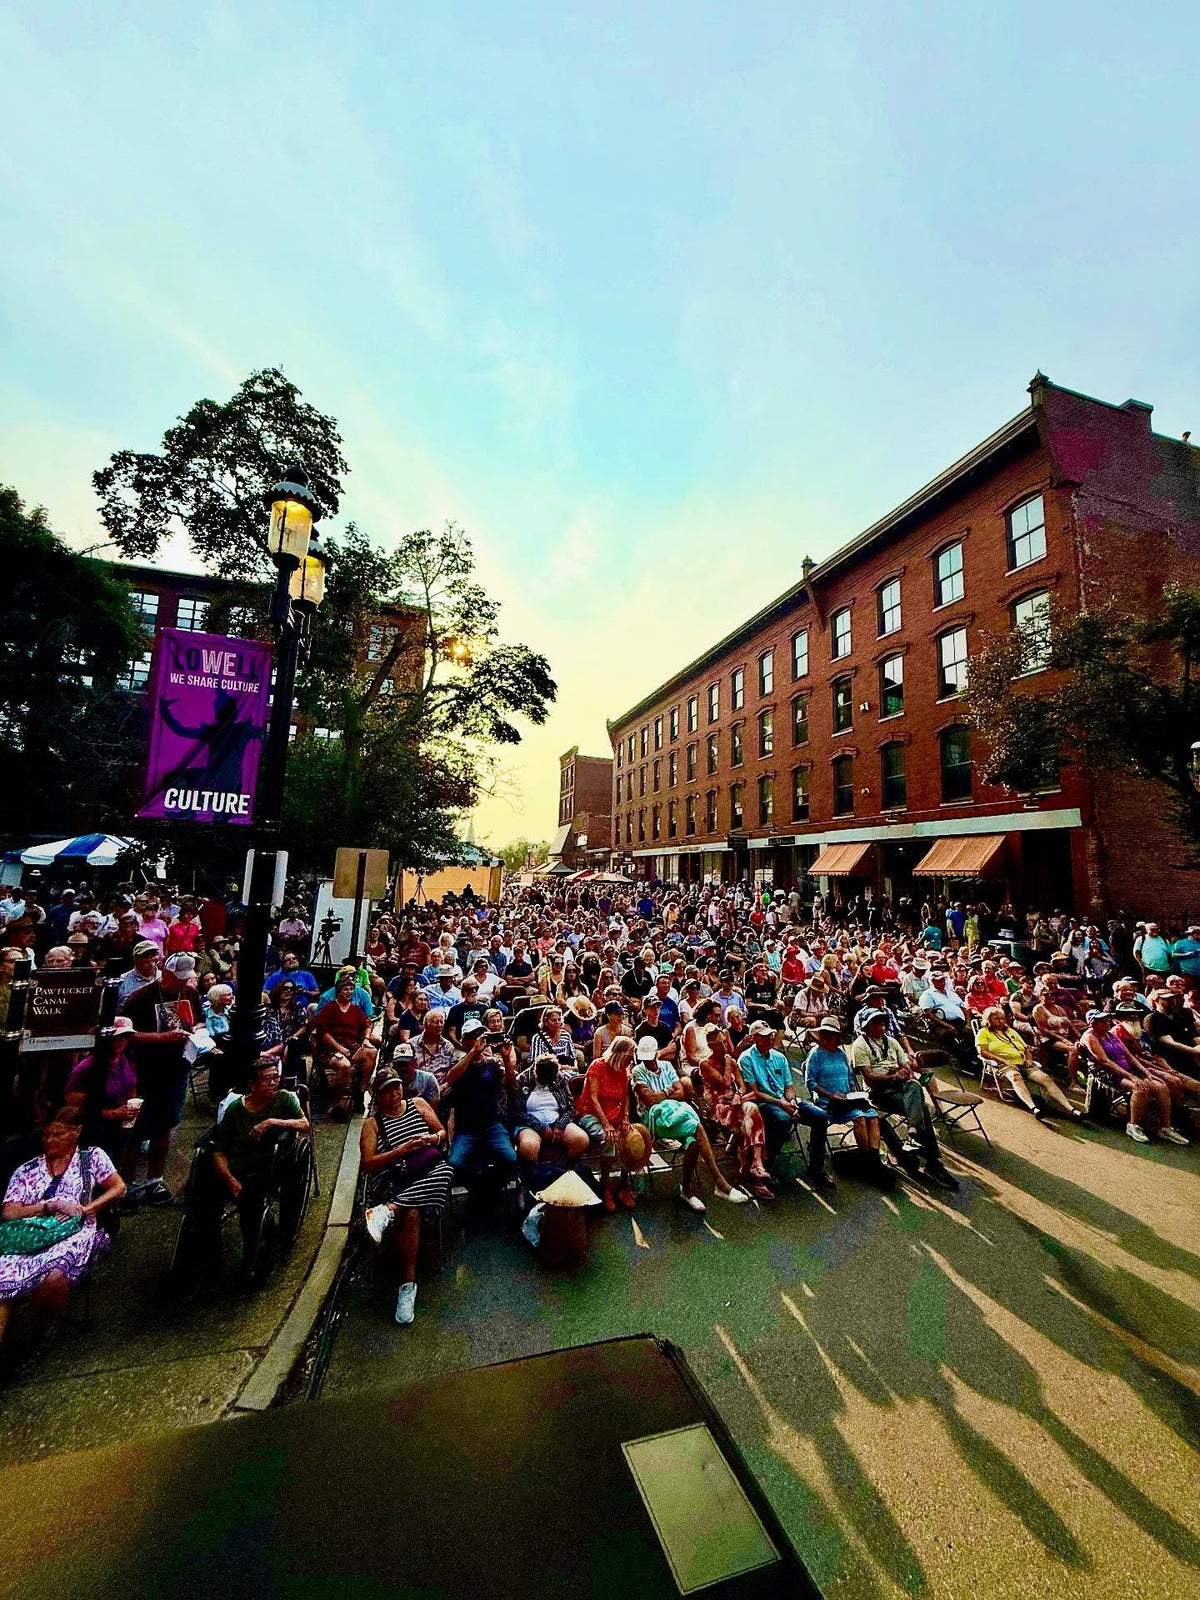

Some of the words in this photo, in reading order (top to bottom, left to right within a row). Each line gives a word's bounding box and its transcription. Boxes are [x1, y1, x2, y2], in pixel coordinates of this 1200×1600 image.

[170, 672, 186, 685] WE
[187, 674, 219, 689] SHARE
[220, 679, 260, 693] CULTURE
[164, 787, 251, 814] CULTURE
[34, 986, 94, 996] PAWTUCKET
[33, 996, 69, 1005] CANAL
[32, 1006, 62, 1015] WALK
